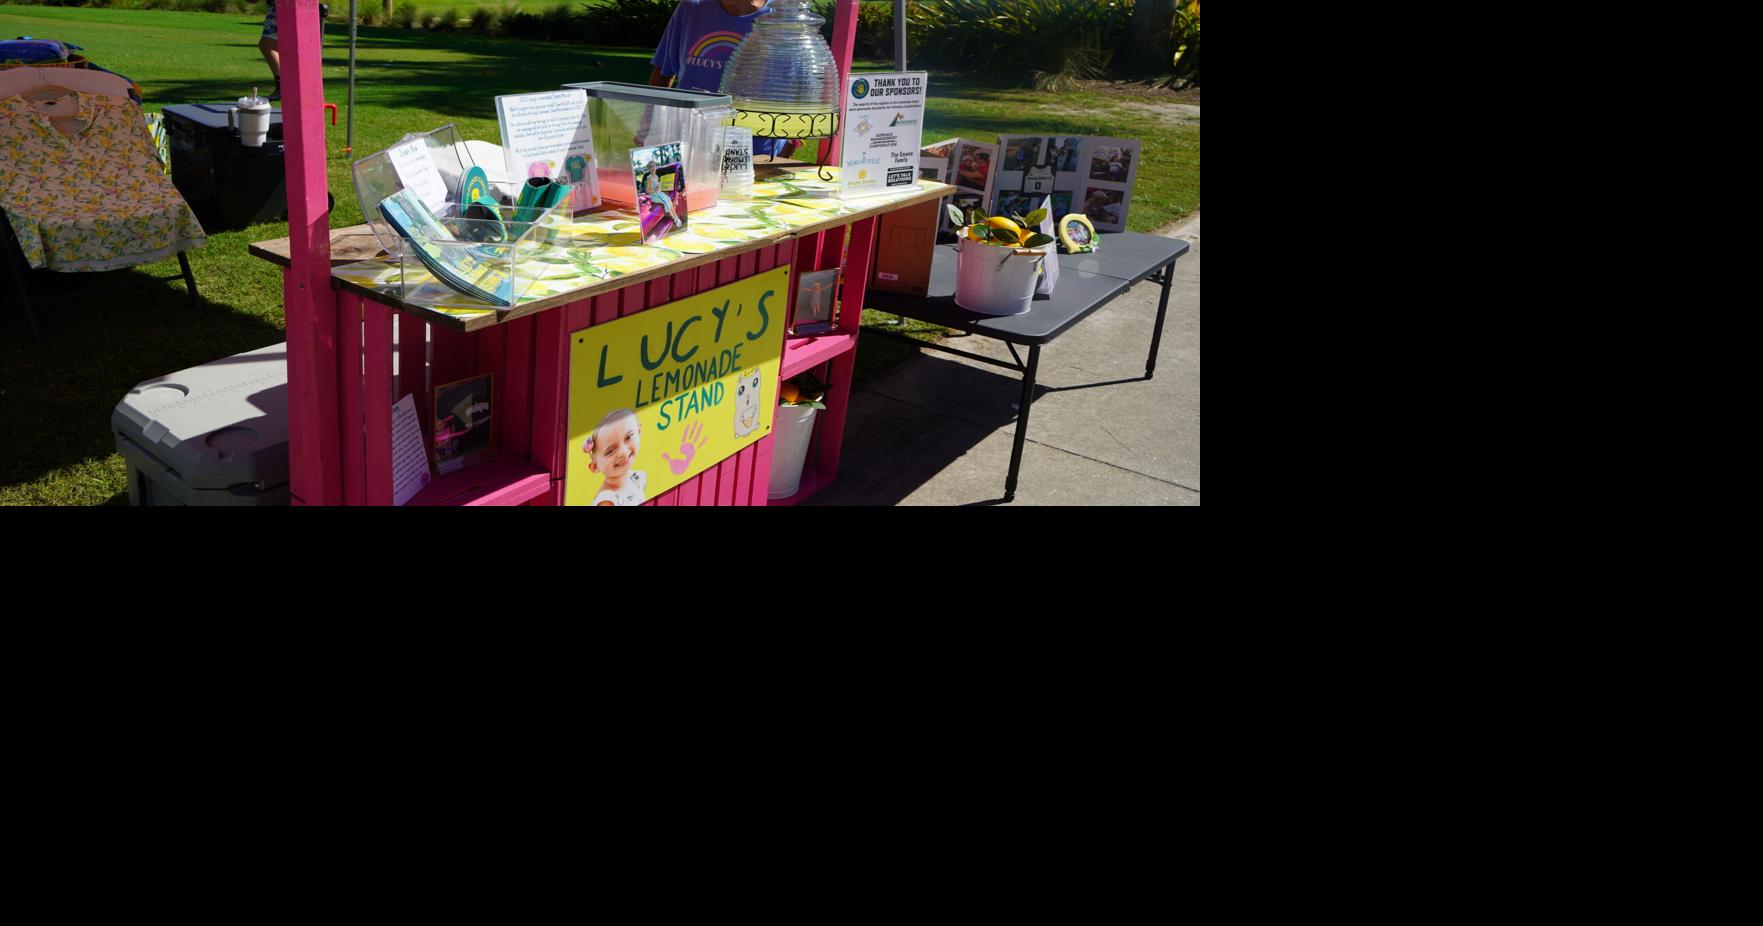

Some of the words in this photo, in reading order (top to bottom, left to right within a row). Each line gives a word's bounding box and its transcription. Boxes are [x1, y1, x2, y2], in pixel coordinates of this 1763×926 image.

[870, 87, 883, 97] OUR
[885, 86, 922, 96] SPONSORS!
[874, 78, 896, 87] THANK
[898, 78, 911, 87] YOU
[911, 77, 920, 86] TO
[597, 289, 774, 389] LUCY'S
[635, 342, 744, 409] LEMONADE
[656, 381, 725, 431] STAND
